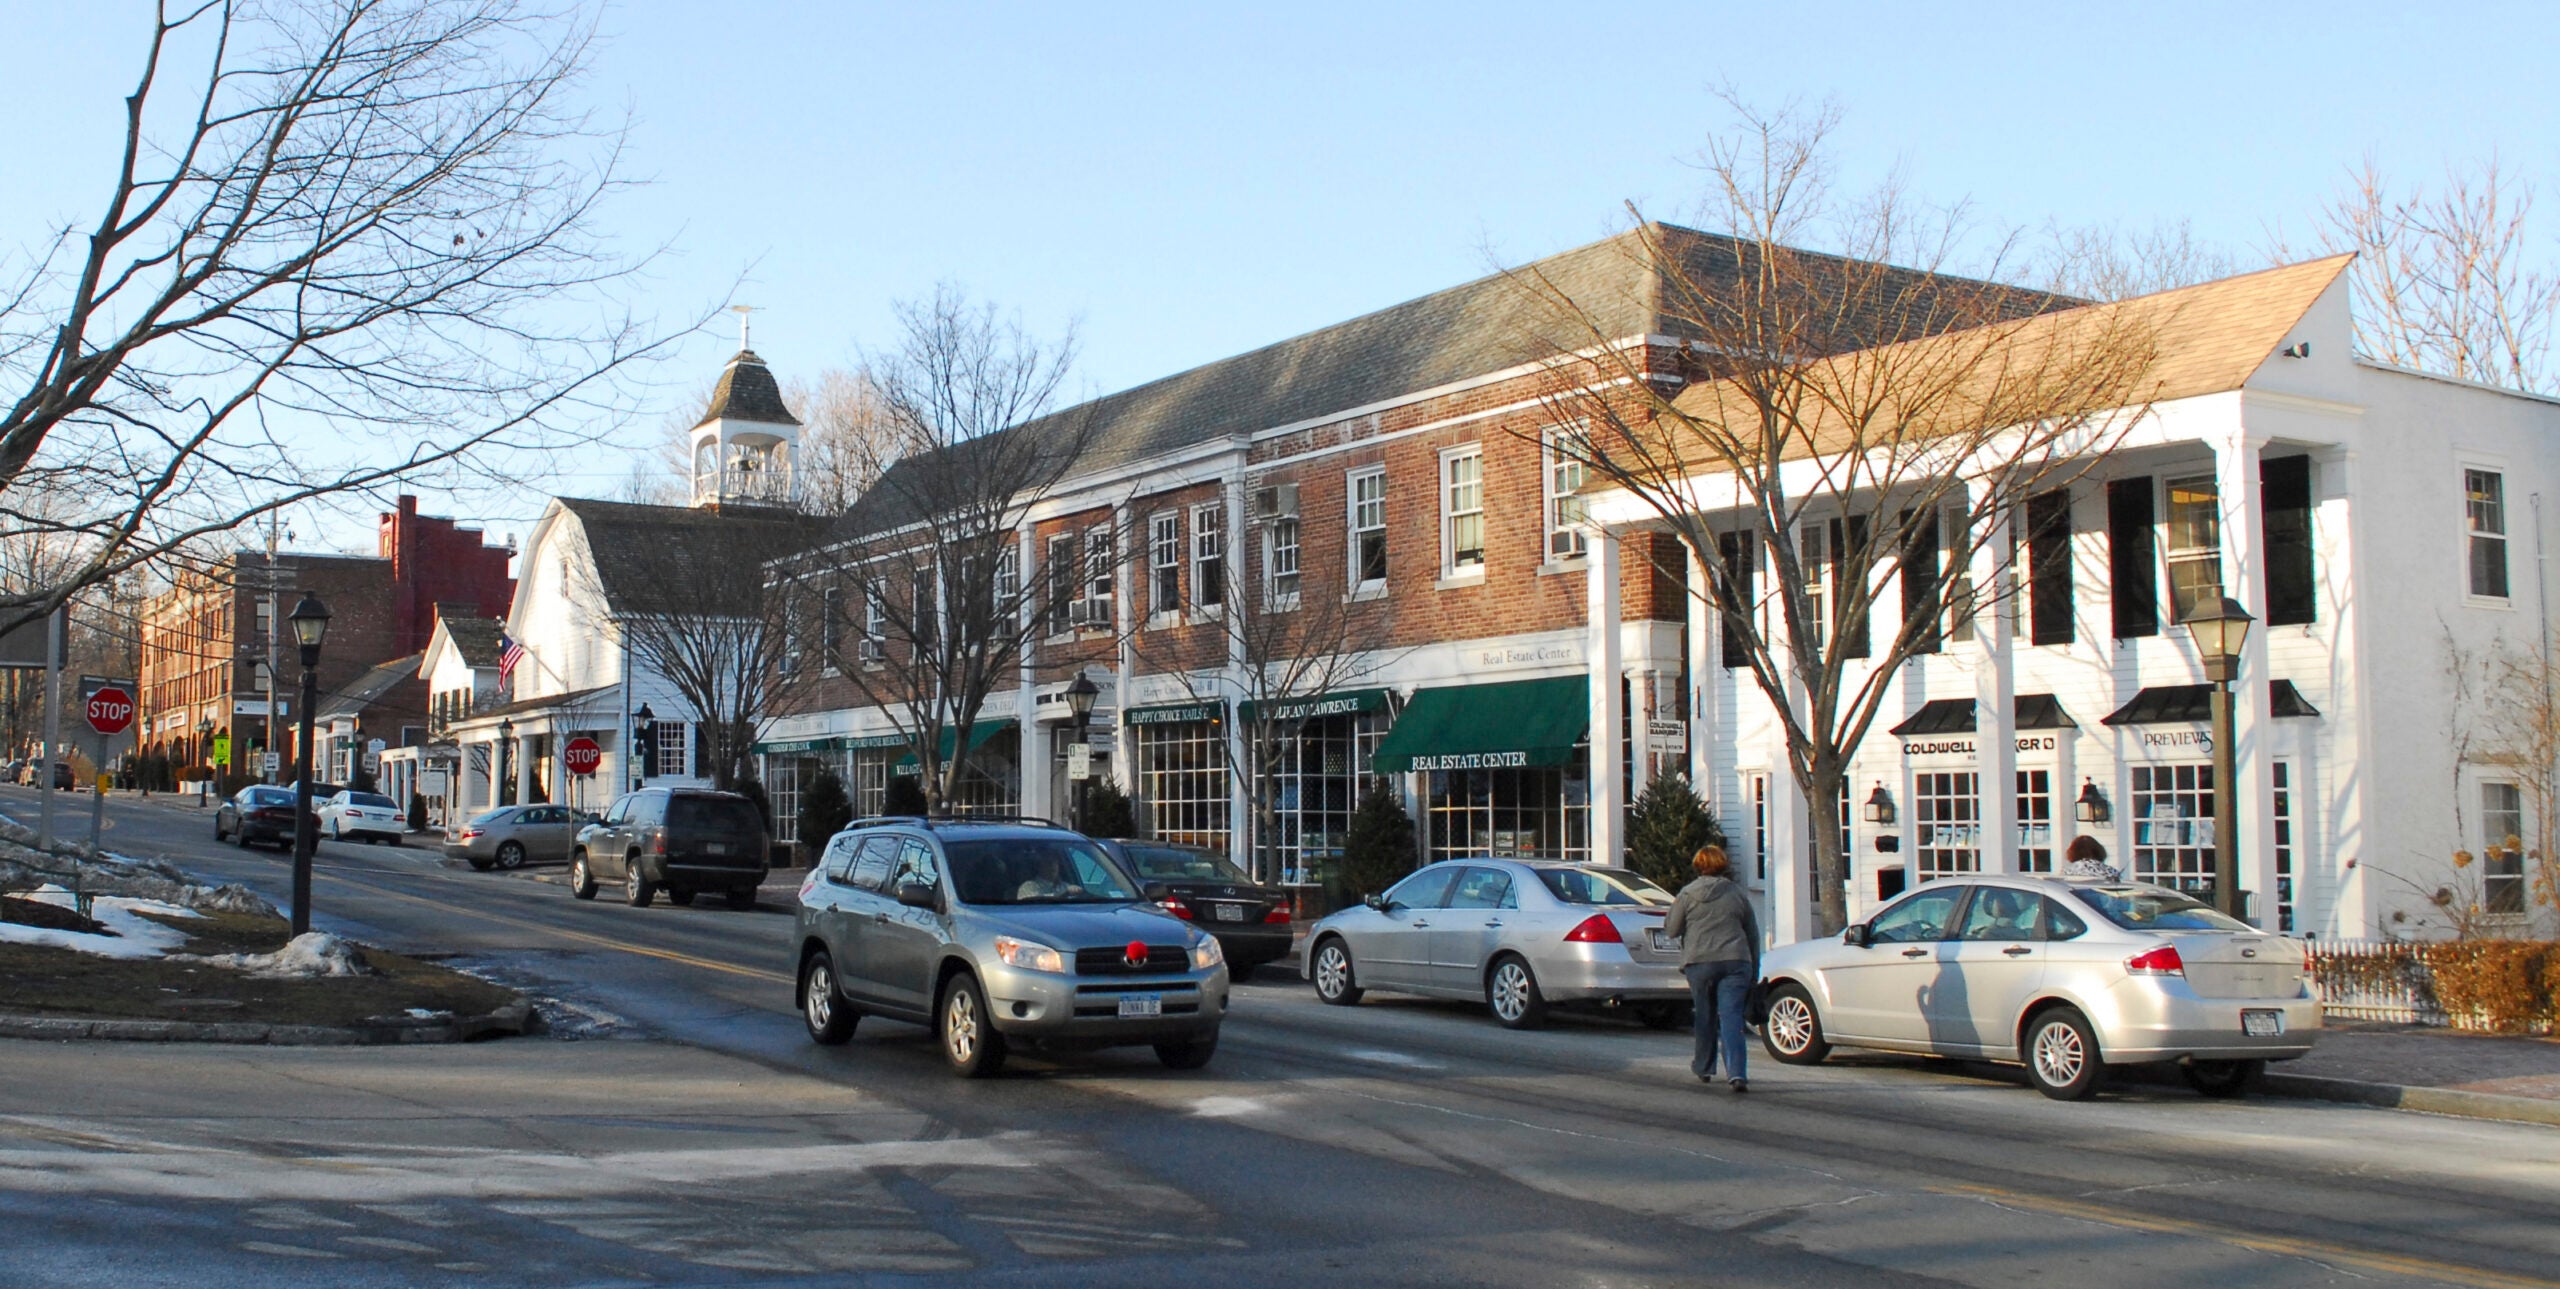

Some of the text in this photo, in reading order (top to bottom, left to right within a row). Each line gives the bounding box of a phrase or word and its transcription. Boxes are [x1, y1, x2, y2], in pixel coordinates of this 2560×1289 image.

[1482, 647, 1571, 665] Real Estate Center
[89, 701, 131, 720] STOP
[1131, 711, 1154, 723] HAPPY
[1154, 709, 1180, 722] CHOICE
[1182, 707, 1202, 720] NAILS
[1310, 698, 1359, 716] LAWRENCE
[1903, 741, 1976, 755] COLDWELL
[2144, 731, 2213, 753] PREVIEWS
[566, 748, 599, 764] STOP
[1412, 751, 1527, 771] REAL ESTATE CENTER
